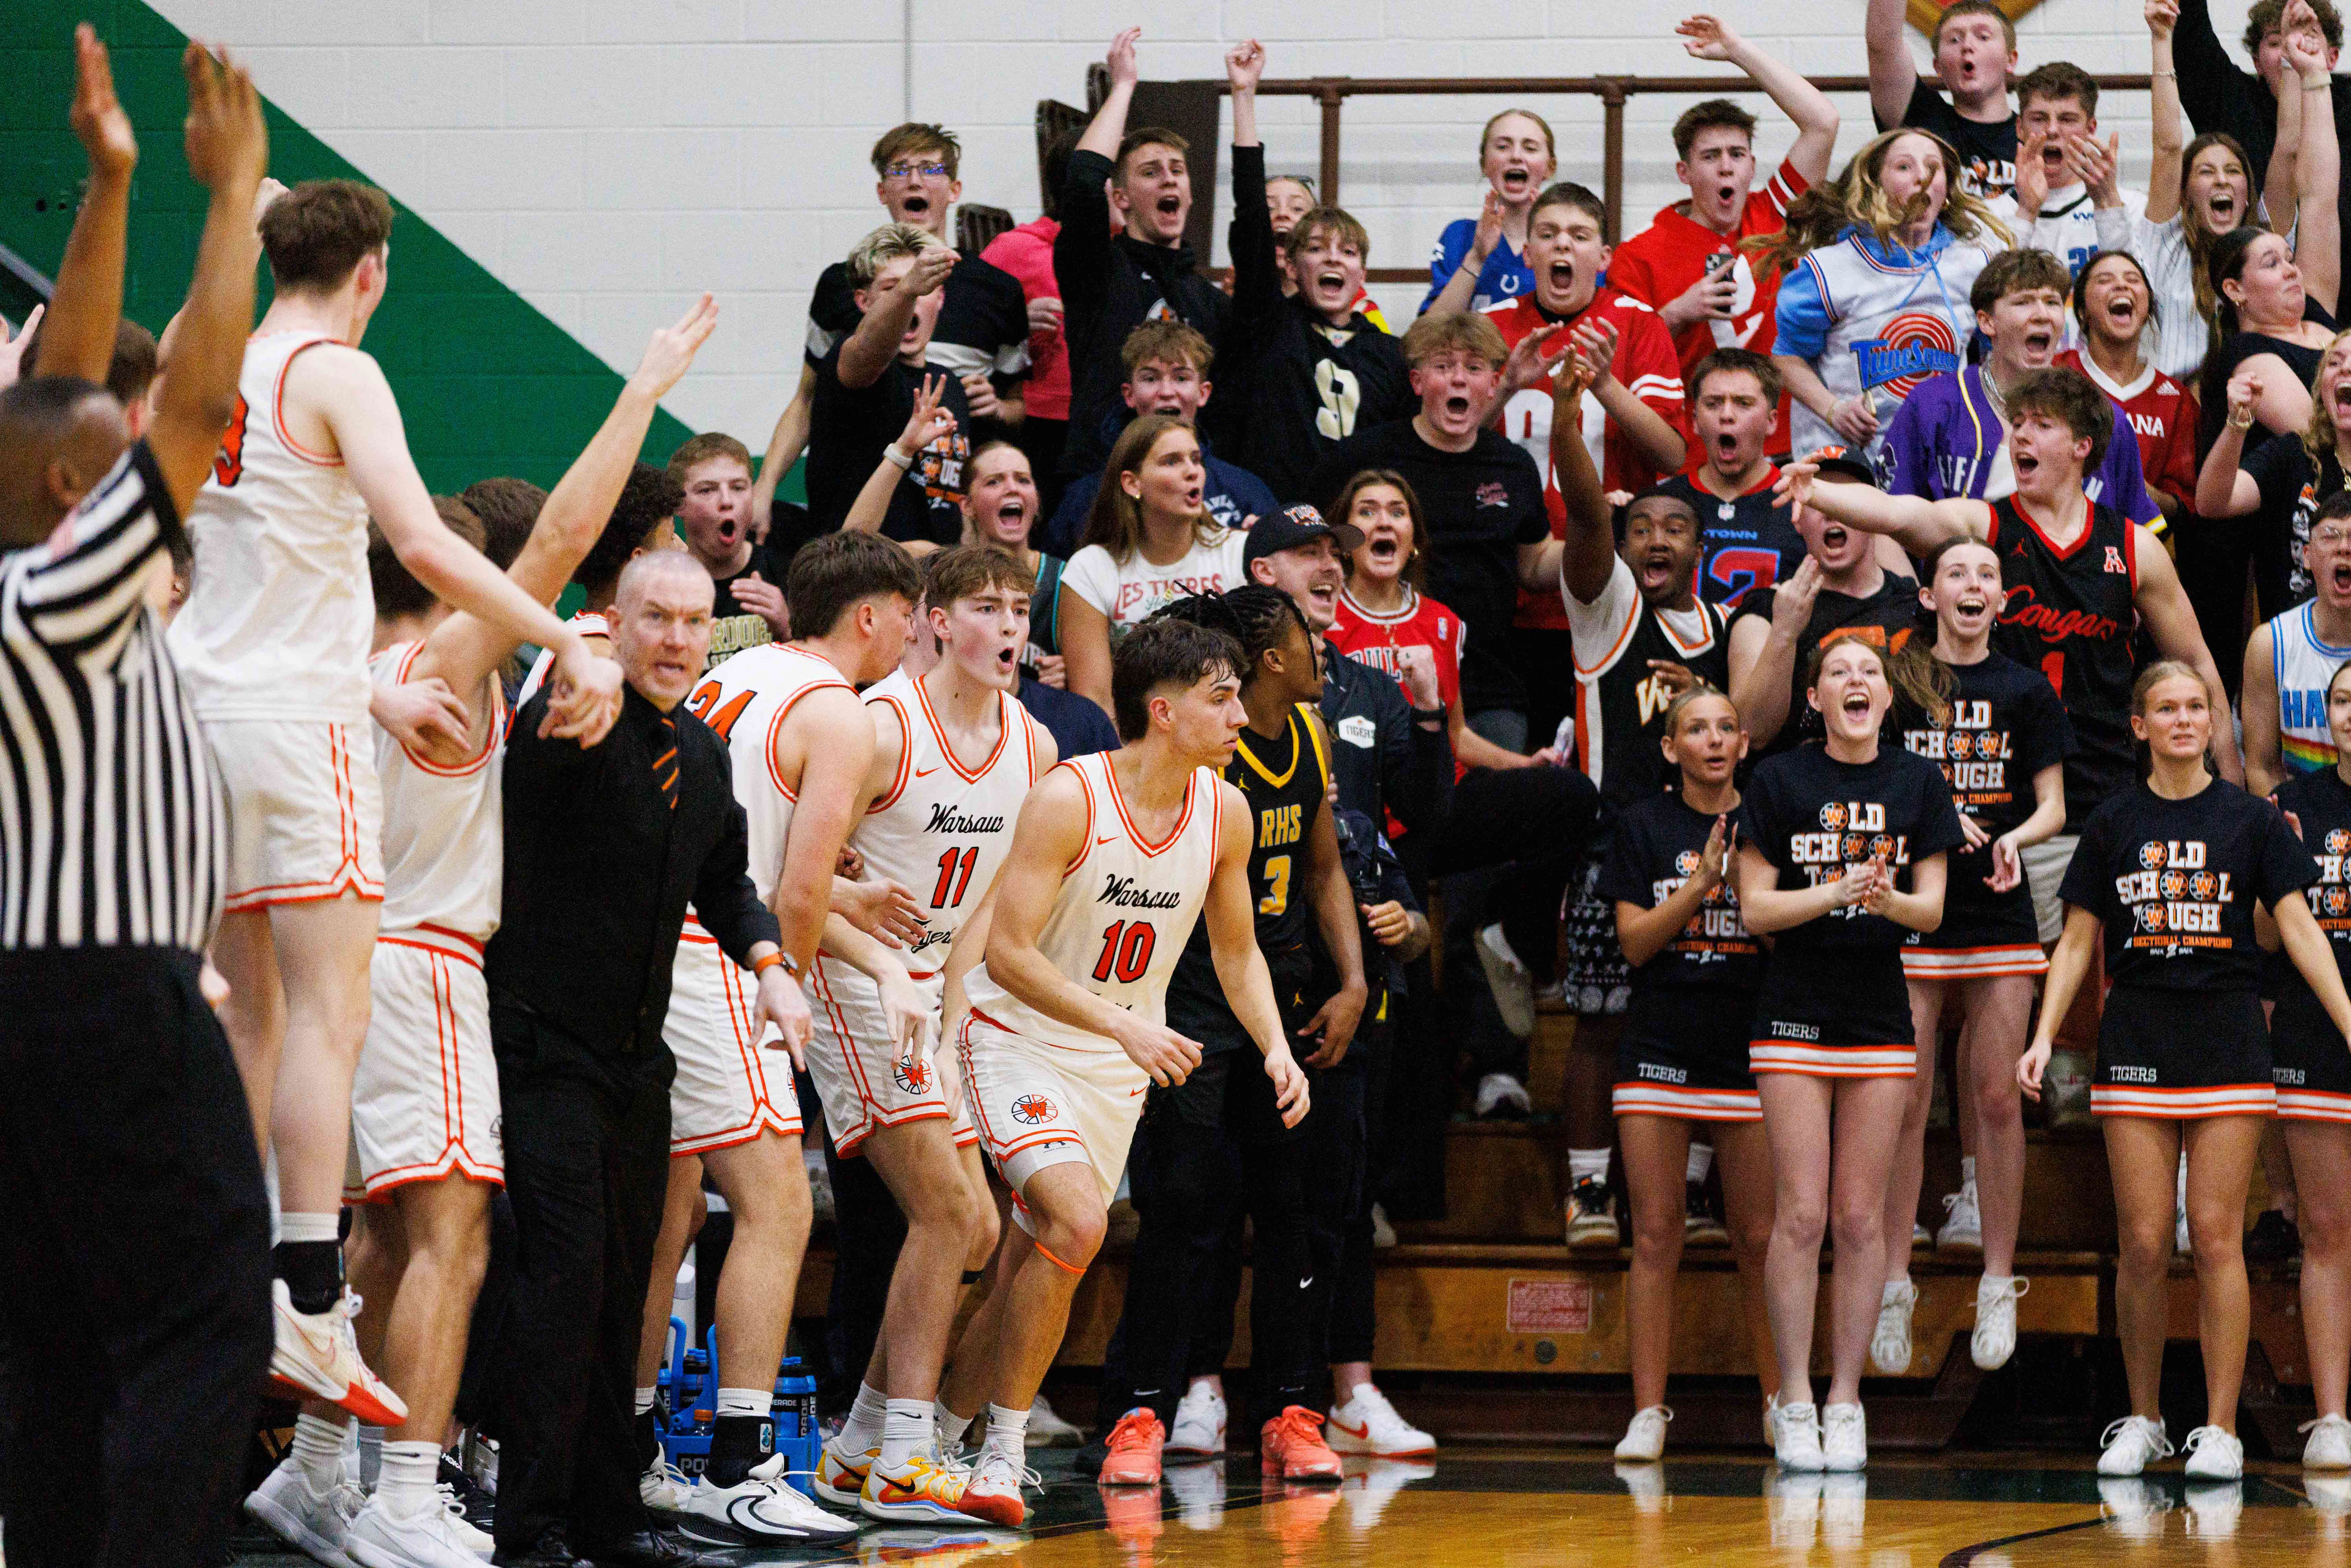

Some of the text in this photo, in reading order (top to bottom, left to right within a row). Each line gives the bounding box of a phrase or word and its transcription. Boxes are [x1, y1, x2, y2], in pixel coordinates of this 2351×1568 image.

[1345, 725, 1375, 738] TIGERS
[923, 803, 1004, 833] Warsaw
[1259, 804, 1302, 849] RHS
[930, 846, 980, 909] 11
[1096, 873, 1180, 909] Warsaw
[1259, 855, 1290, 916] 3
[1092, 920, 1156, 984] 10
[1771, 1021, 1819, 1040] TIGERS
[1638, 1063, 1687, 1084] TIGERS
[2110, 1065, 2156, 1083] TIGERS
